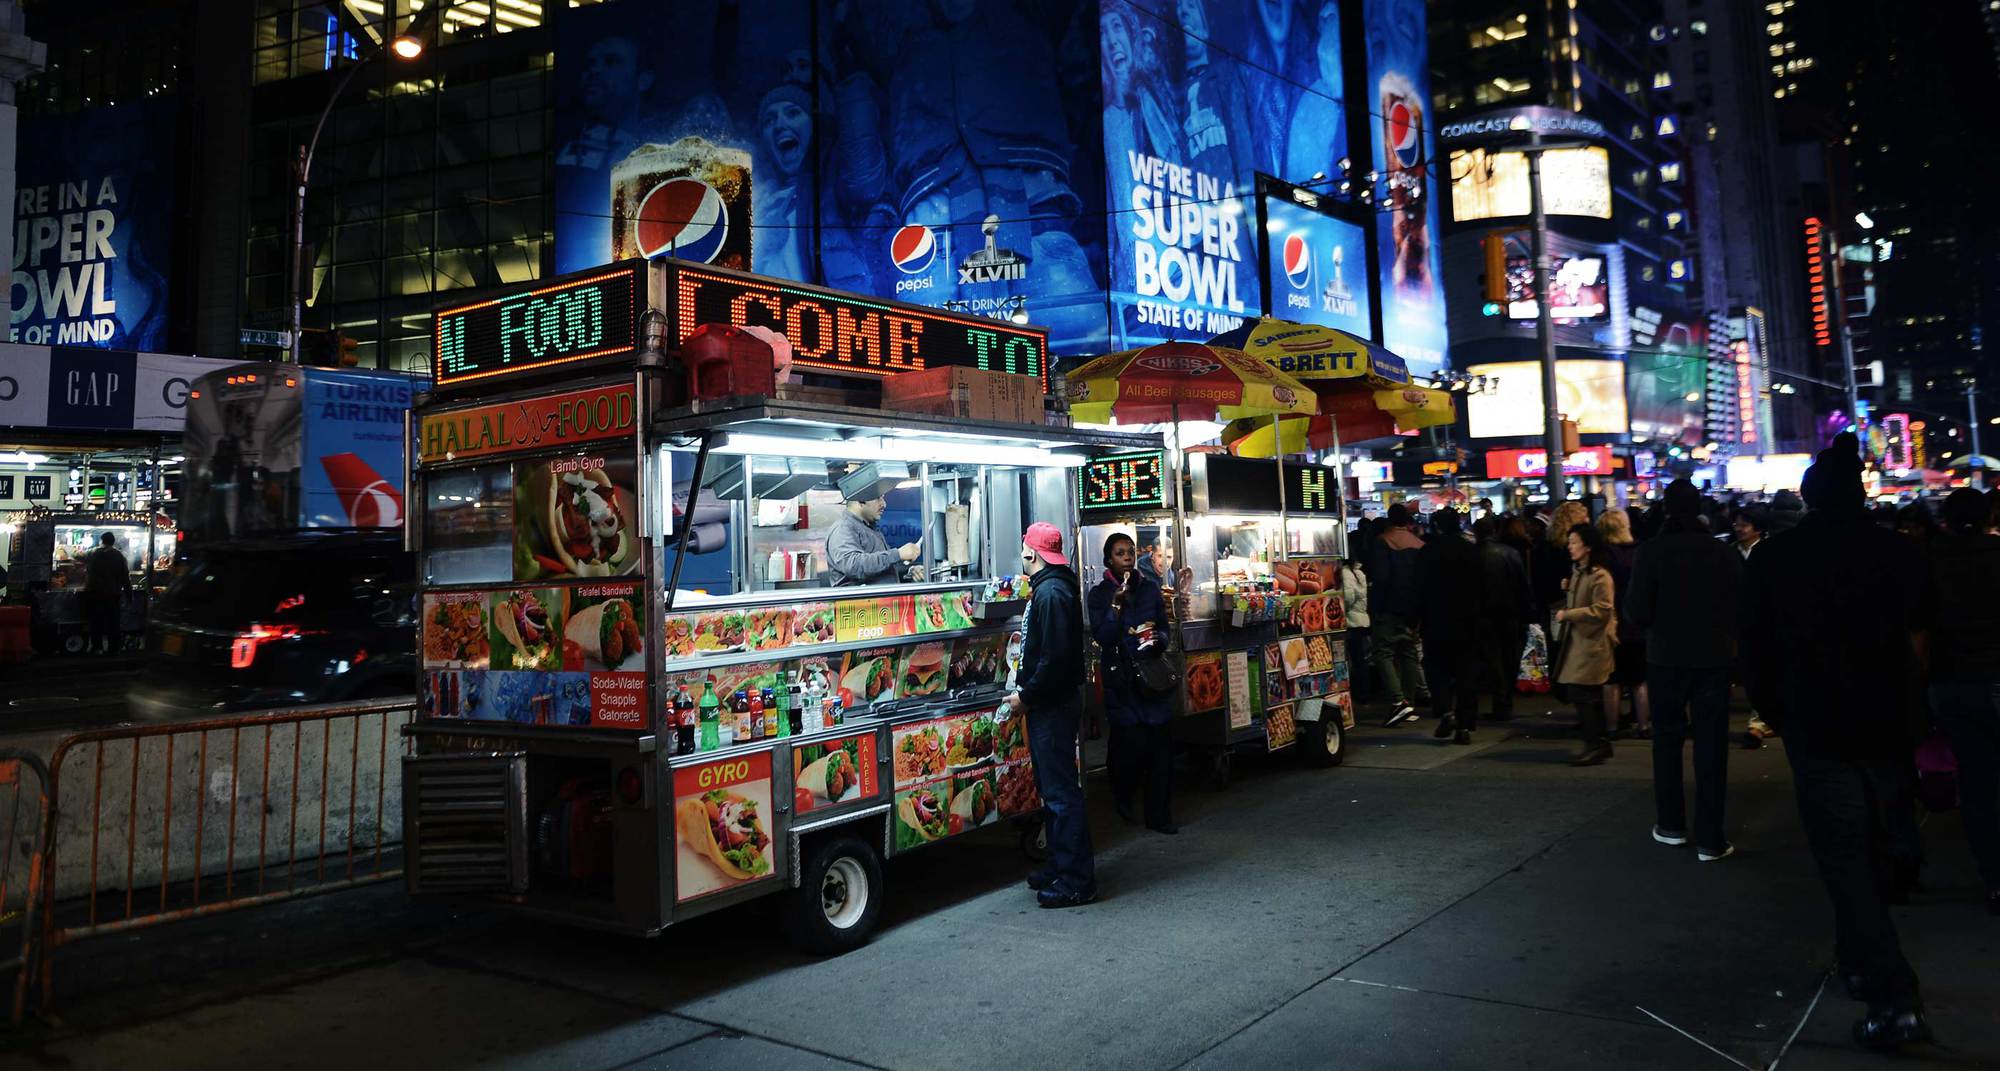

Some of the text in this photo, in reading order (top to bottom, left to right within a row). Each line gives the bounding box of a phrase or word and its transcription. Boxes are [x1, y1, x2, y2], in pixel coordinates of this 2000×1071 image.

[1441, 117, 1510, 137] COMCAST
[1128, 150, 1192, 198] WE'RE
[1197, 172, 1218, 205] IN
[58, 179, 88, 211] IN
[97, 176, 118, 206] A
[1132, 185, 1242, 262] SUPER
[12, 209, 118, 270] UPER
[896, 276, 934, 294] pepsi
[958, 263, 1026, 285] XLVIII
[1134, 240, 1244, 313] BOWL
[10, 262, 116, 324] OWL
[1288, 293, 1310, 310] pepsi
[501, 286, 602, 363] FOOD
[1137, 300, 1181, 328] STATE
[1184, 308, 1203, 329] OF
[25, 325, 51, 344] OF
[57, 319, 115, 344] MIND
[1254, 328, 1321, 347] SABRETT
[1149, 356, 1202, 369] NIKAS
[66, 369, 119, 408] GAP
[325, 383, 411, 404] TURKIS
[1125, 385, 1141, 396] All
[558, 391, 636, 438] FOOD
[426, 411, 512, 457] HALAL
[550, 456, 605, 473] Lamb Gyro
[1301, 469, 1325, 509] H
[578, 586, 634, 597] Falafel Sandwich
[839, 599, 900, 630] Halal
[857, 627, 884, 639] FOOD
[593, 676, 644, 690] Soda-Water
[600, 693, 637, 706] Snapple
[599, 709, 640, 722] Gatorade
[698, 759, 750, 788] GYRO
